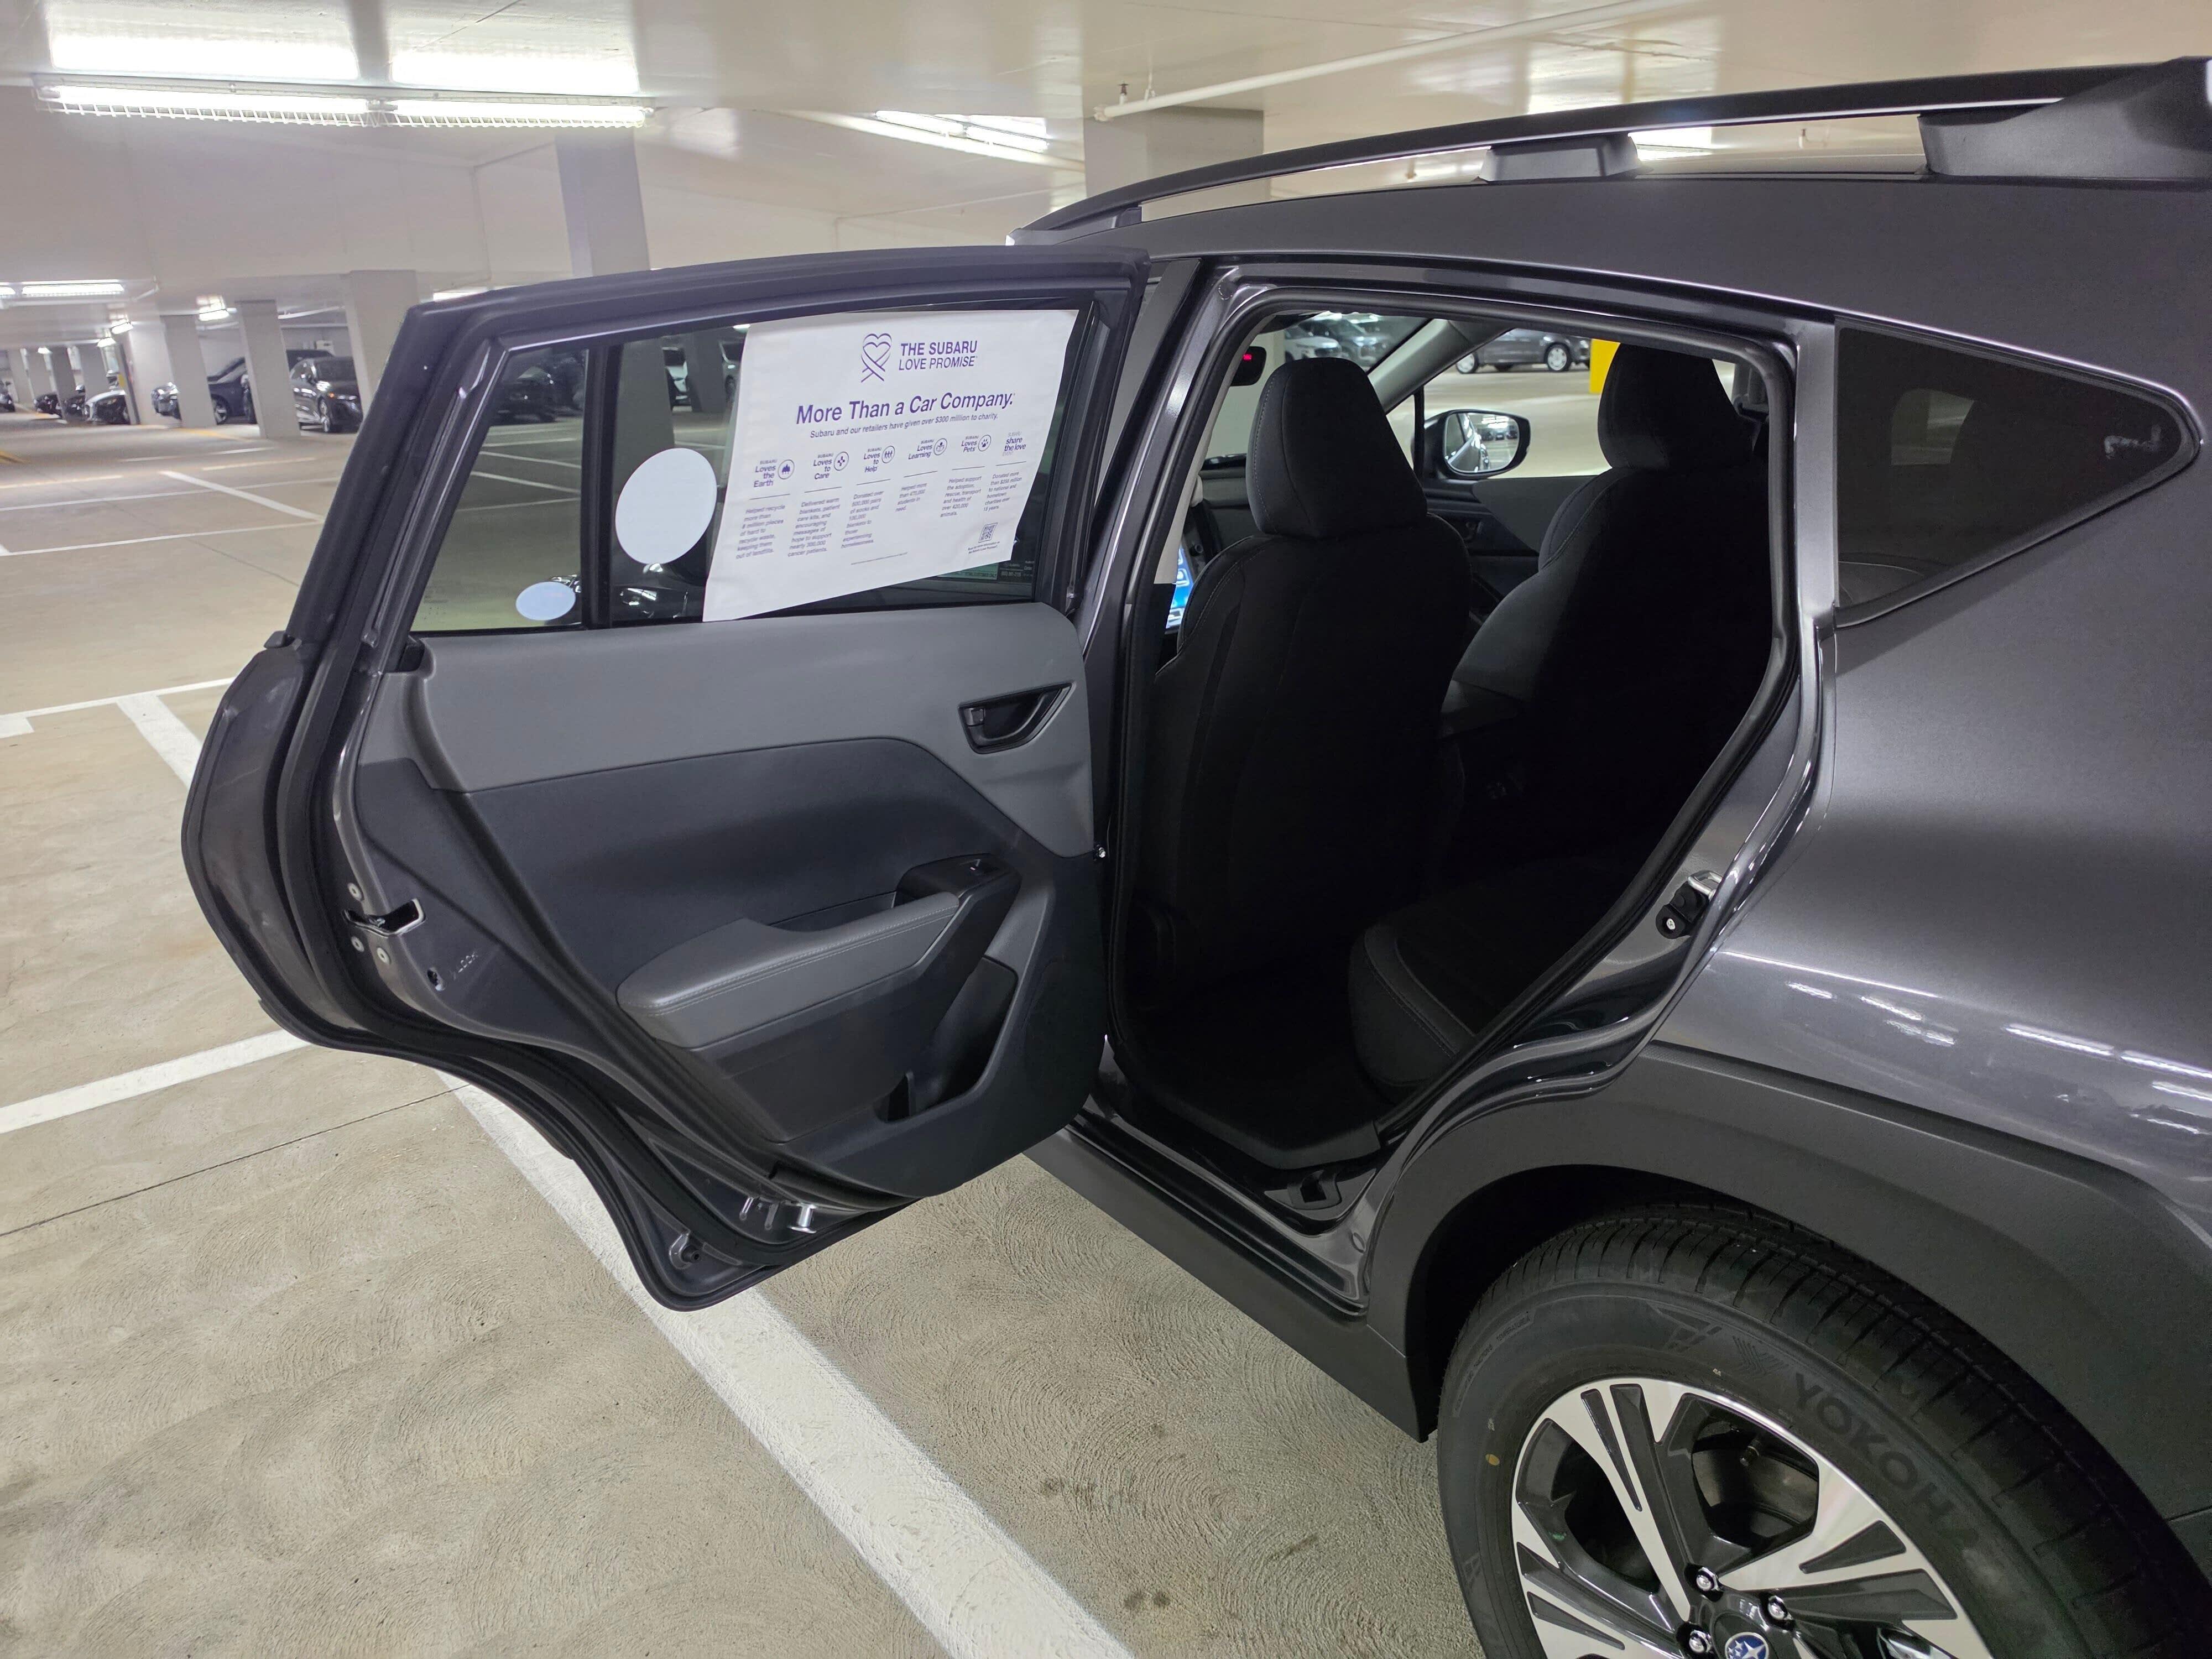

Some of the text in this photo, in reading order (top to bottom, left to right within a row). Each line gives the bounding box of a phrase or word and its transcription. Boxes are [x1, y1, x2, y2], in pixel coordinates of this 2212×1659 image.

[901, 340, 977, 356] THE SUBARU
[899, 358, 927, 371] LOVE
[796, 392, 1013, 424] More Than a Car Company.
[810, 429, 834, 438] Subaru
[836, 427, 849, 436] and
[862, 424, 888, 433] retailers
[904, 419, 920, 429] given
[935, 415, 949, 424] $300
[950, 414, 969, 422] million
[978, 413, 998, 421] charity.
[1006, 436, 1022, 445] share
[908, 451, 932, 460] Learning
[813, 458, 832, 467] Loves
